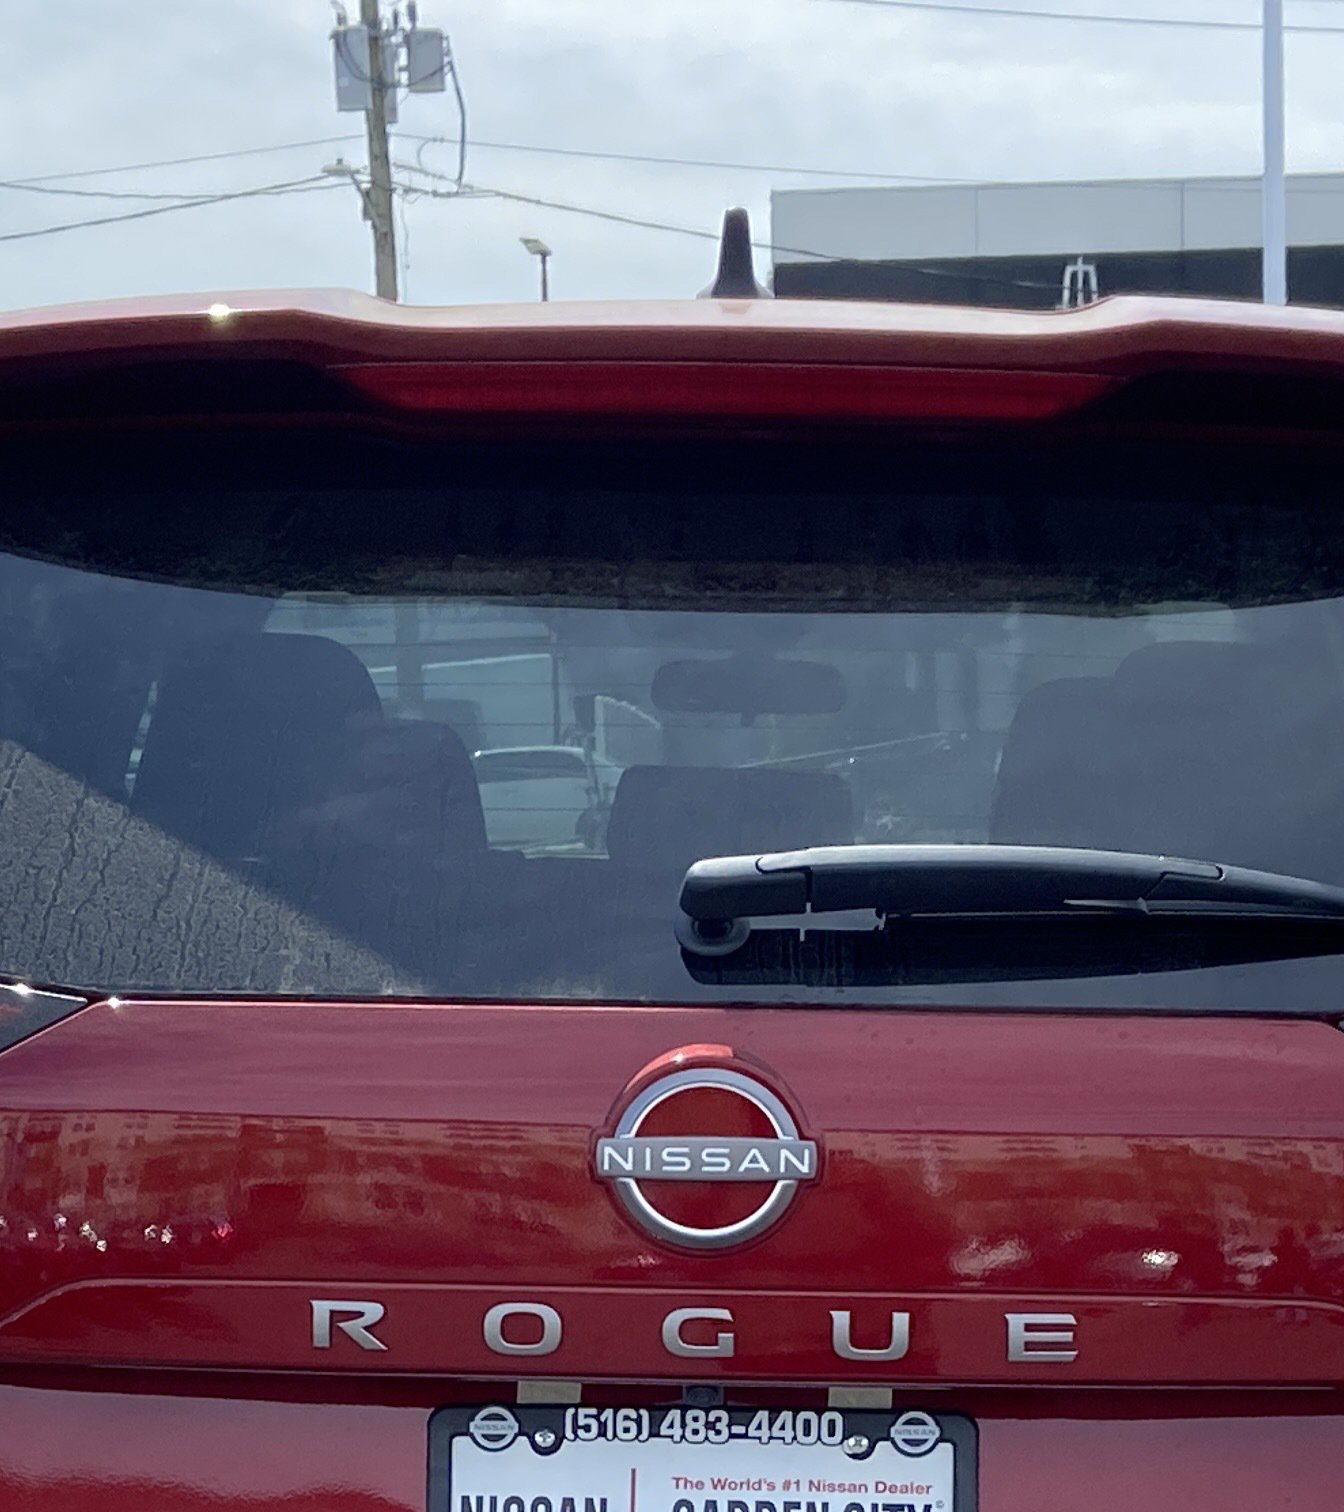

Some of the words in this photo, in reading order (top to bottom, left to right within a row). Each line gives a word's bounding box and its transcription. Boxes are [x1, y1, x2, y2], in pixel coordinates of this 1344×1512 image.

[602, 1145, 810, 1174] NISSAN
[309, 1299, 1079, 1364] ROGUE
[564, 1407, 650, 1442] (516)
[659, 1408, 845, 1446] 483-4400
[672, 1476, 705, 1491] The
[710, 1477, 777, 1492] World's
[782, 1479, 801, 1493] #1
[808, 1479, 869, 1494] Nissan
[874, 1481, 933, 1495] Dealer
